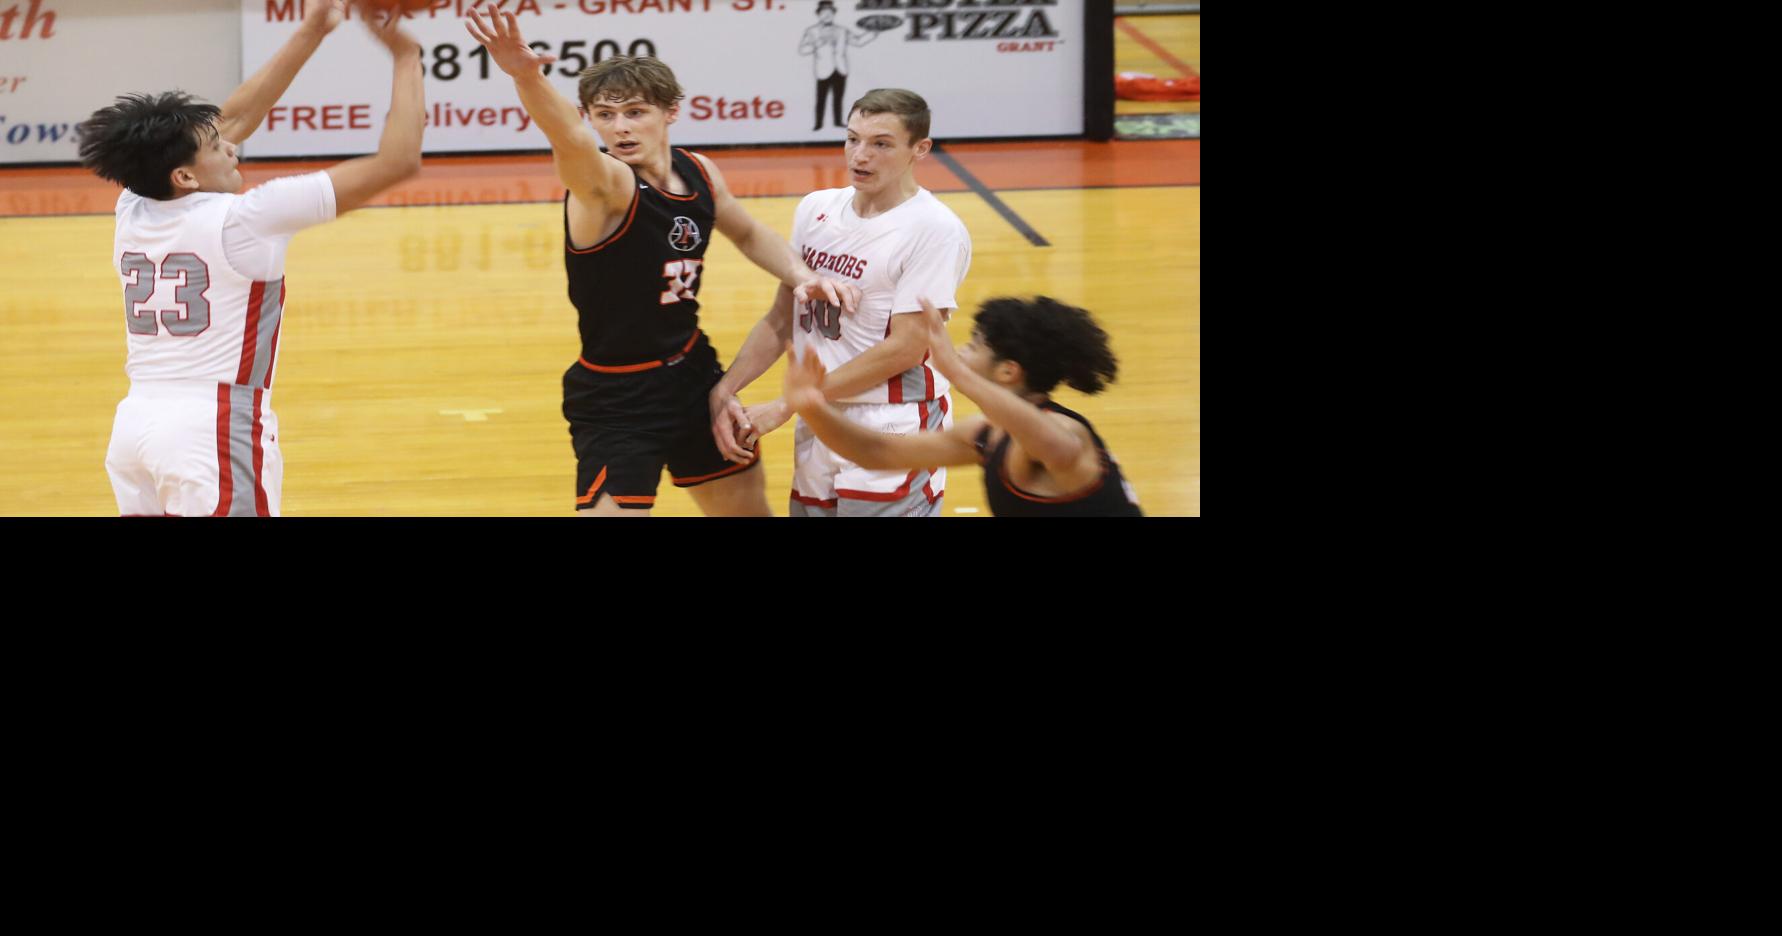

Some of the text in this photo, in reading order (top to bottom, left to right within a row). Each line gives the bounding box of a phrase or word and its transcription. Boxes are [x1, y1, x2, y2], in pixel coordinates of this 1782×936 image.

[905, 9, 1059, 41] PIZZA
[996, 41, 1056, 52] GRANT
[267, 105, 371, 131] FREE
[689, 95, 785, 121] State
[120, 252, 211, 337] 23
